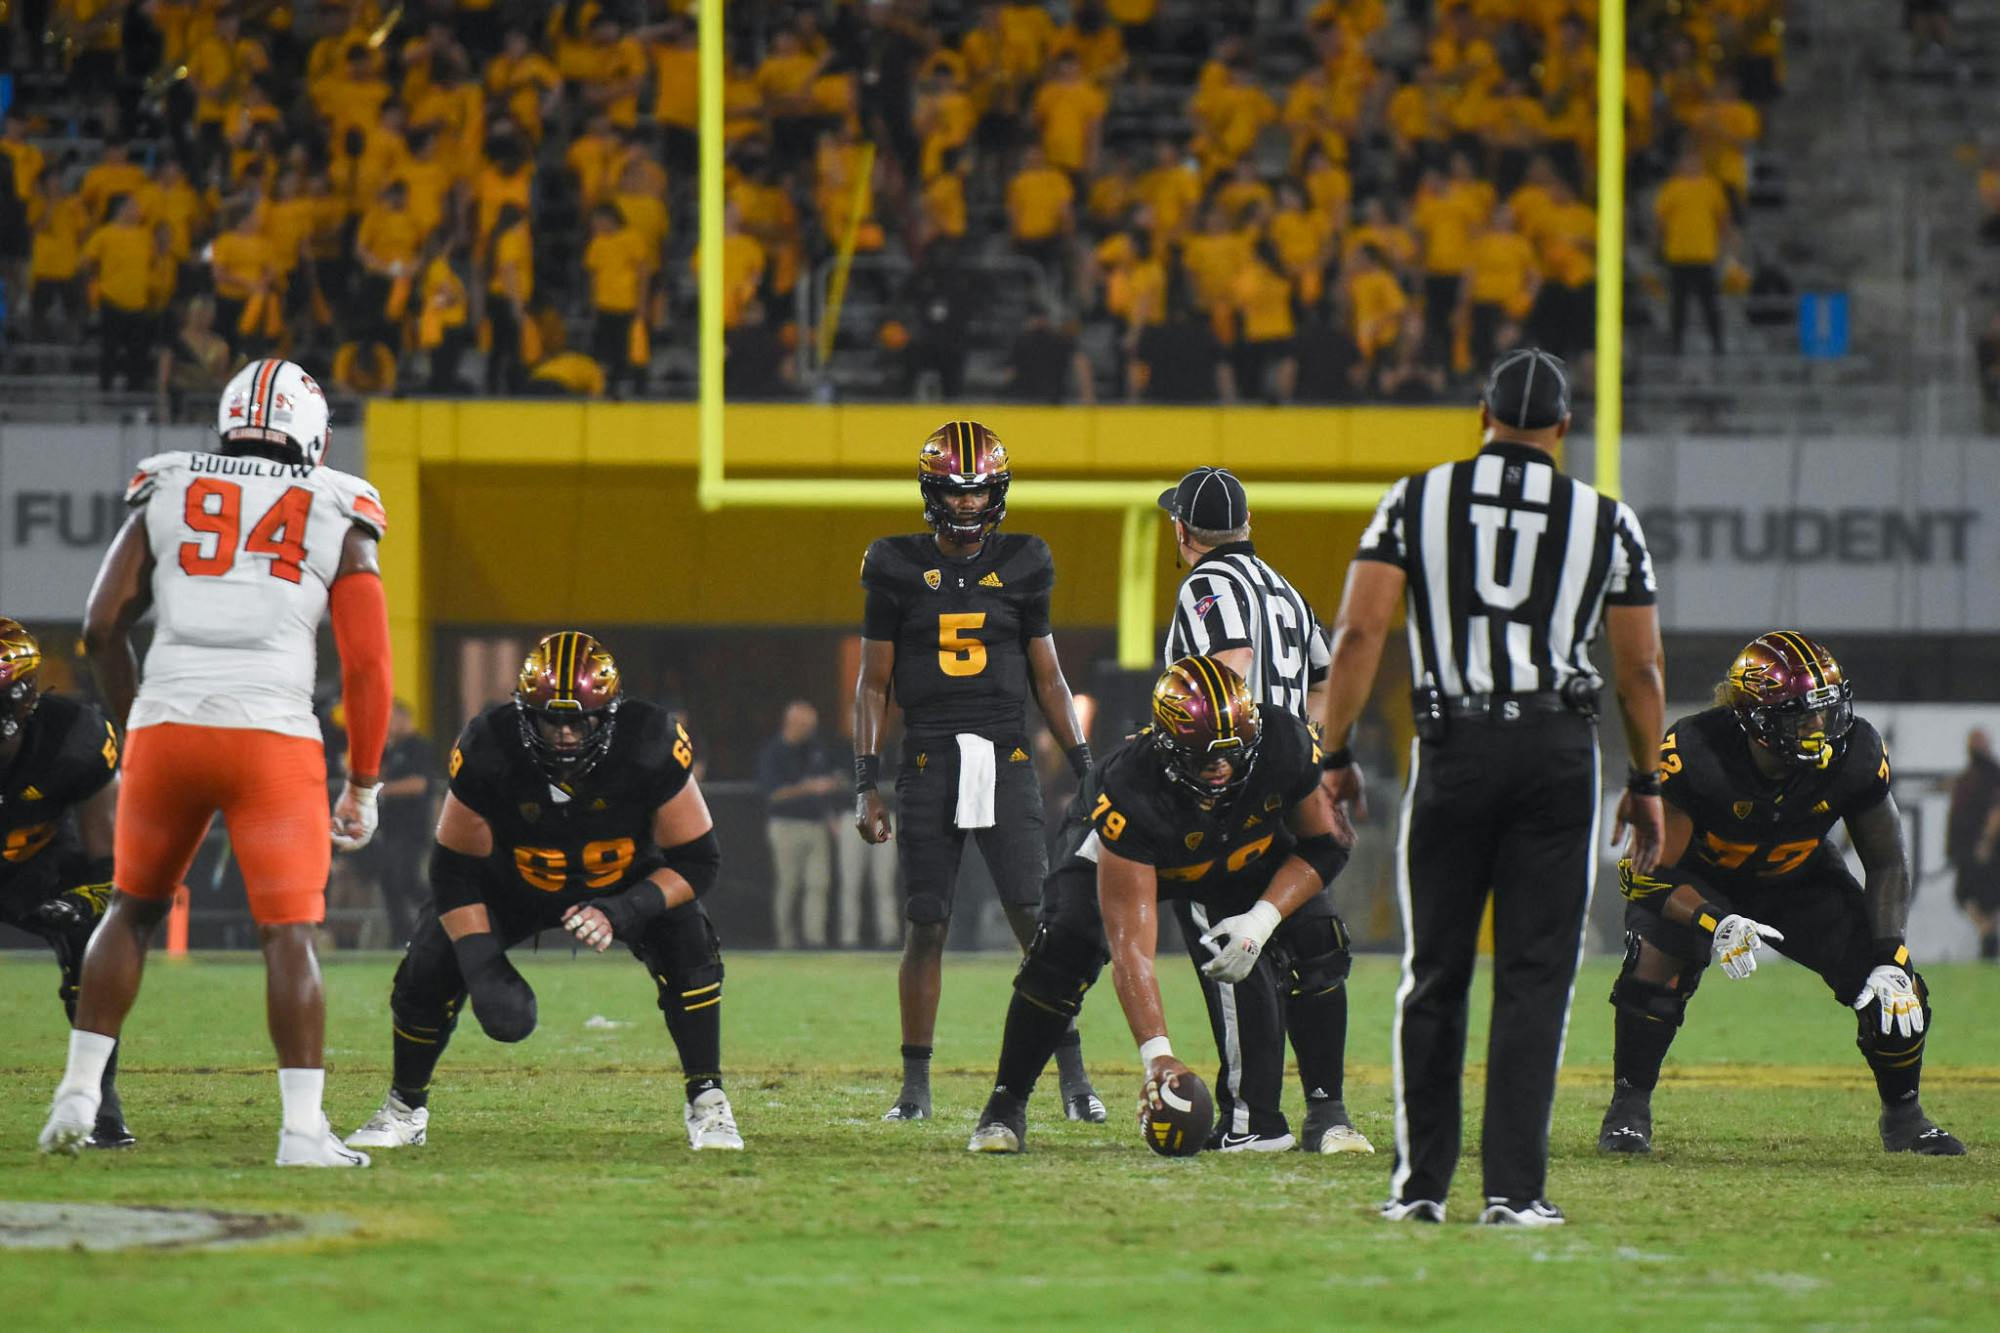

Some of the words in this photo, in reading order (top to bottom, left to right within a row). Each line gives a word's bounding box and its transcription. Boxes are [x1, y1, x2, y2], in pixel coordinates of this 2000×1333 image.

[16, 491, 125, 547] FU
[178, 477, 313, 585] 94
[1470, 504, 1548, 610] U
[938, 613, 987, 676] 5
[1266, 594, 1302, 679] C
[1091, 793, 1128, 841] 79
[513, 838, 635, 892] 69
